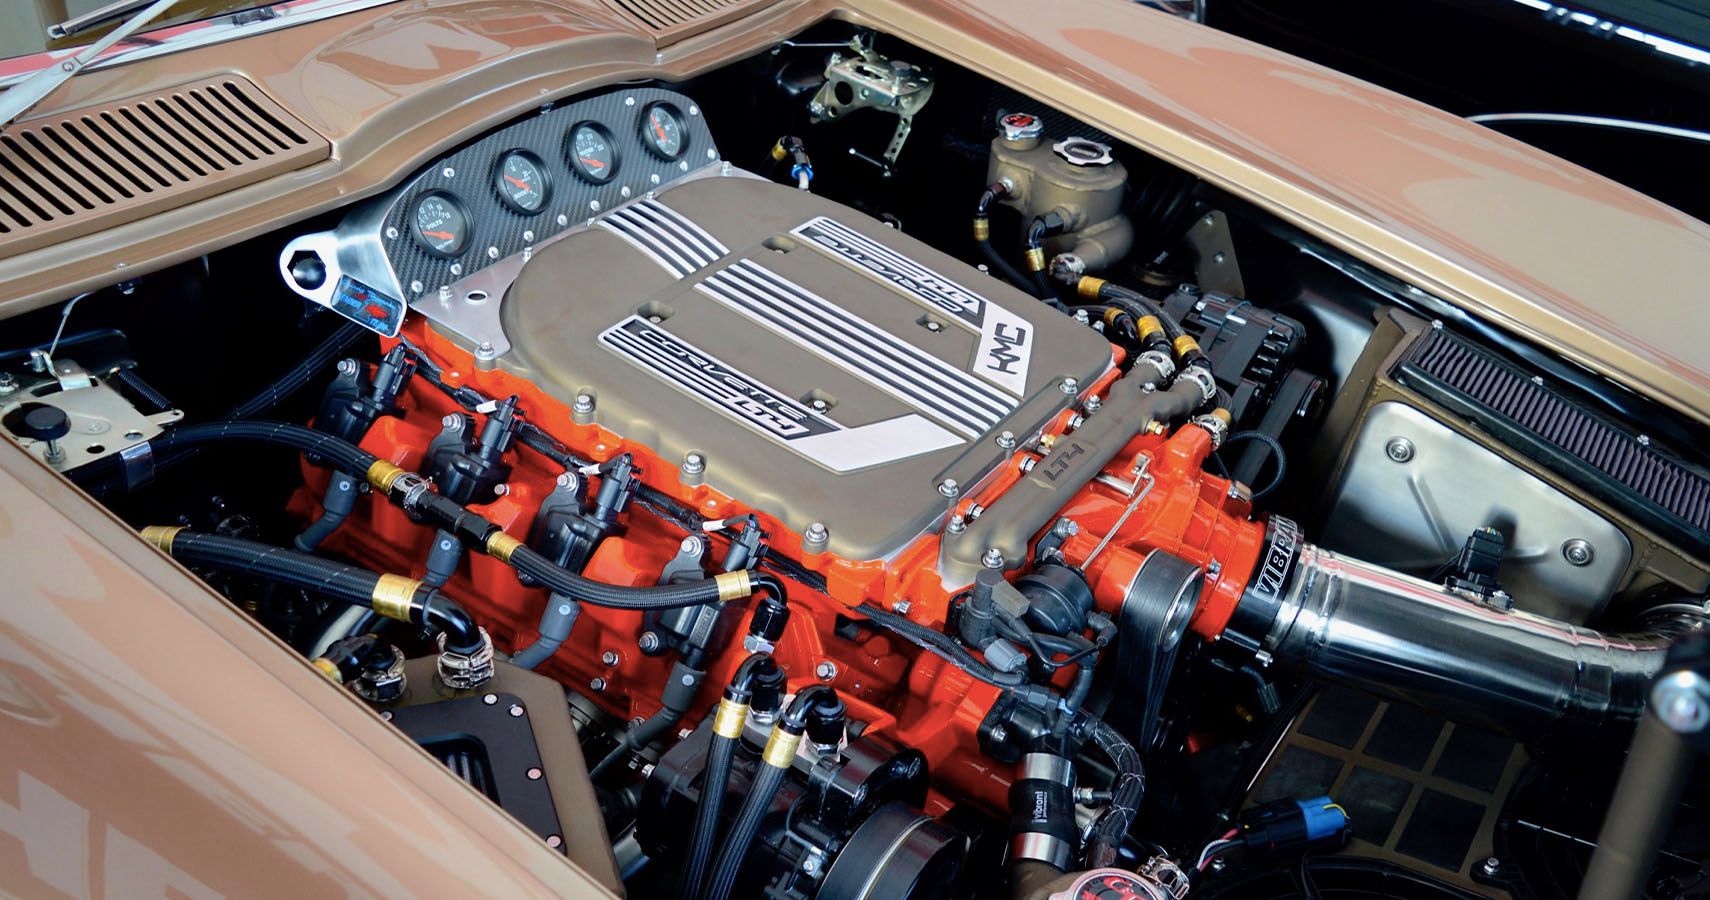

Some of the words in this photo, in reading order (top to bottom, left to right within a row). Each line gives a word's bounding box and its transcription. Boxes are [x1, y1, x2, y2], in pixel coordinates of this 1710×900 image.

[426, 218, 443, 229] VOLTS
[813, 234, 964, 313] CORVETTE
[639, 329, 808, 421] CORVETTE
[986, 322, 1026, 375] KMC
[1043, 442, 1086, 481] LT4
